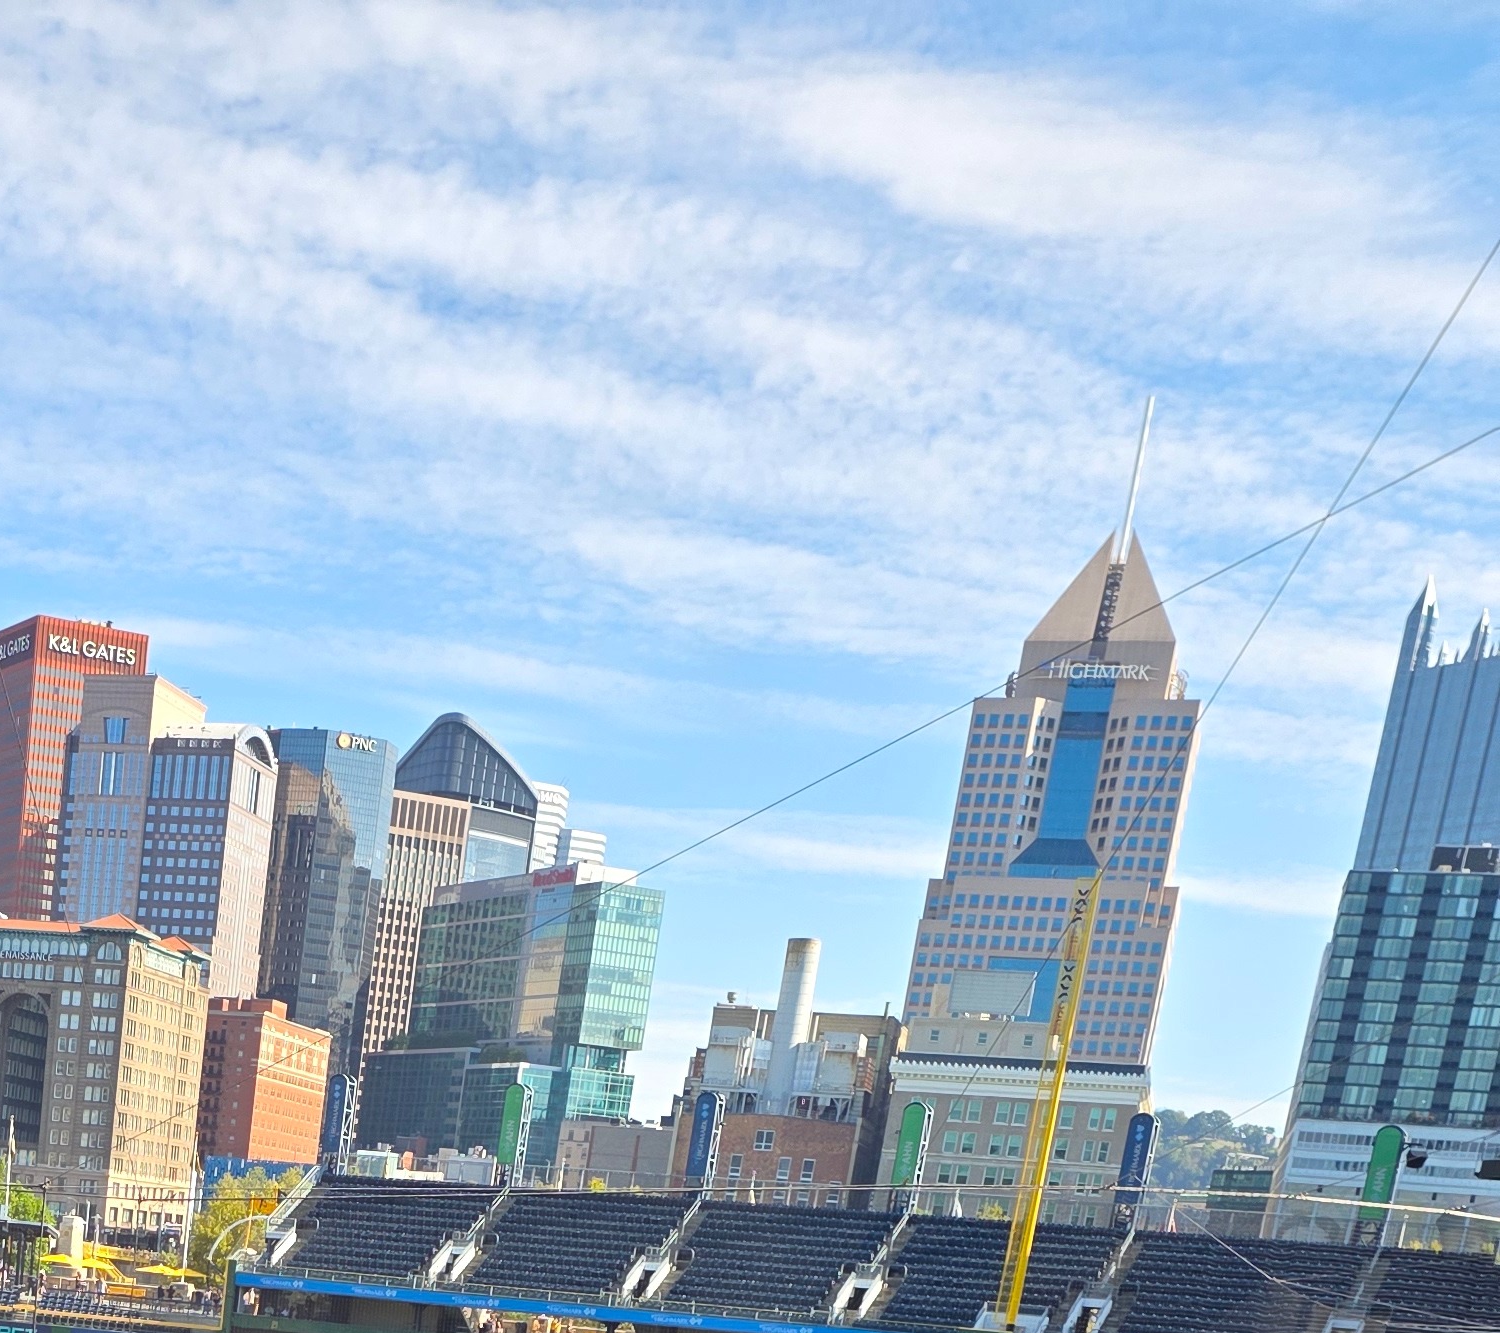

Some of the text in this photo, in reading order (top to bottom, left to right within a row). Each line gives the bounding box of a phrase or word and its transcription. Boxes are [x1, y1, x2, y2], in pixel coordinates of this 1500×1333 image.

[7, 634, 30, 656] GATES
[48, 633, 137, 666] K&L GATES
[1048, 658, 1150, 682] HIGHMARK
[351, 736, 378, 753] PNC
[903, 1141, 915, 1165] AHN
[1372, 1167, 1387, 1193] AHN
